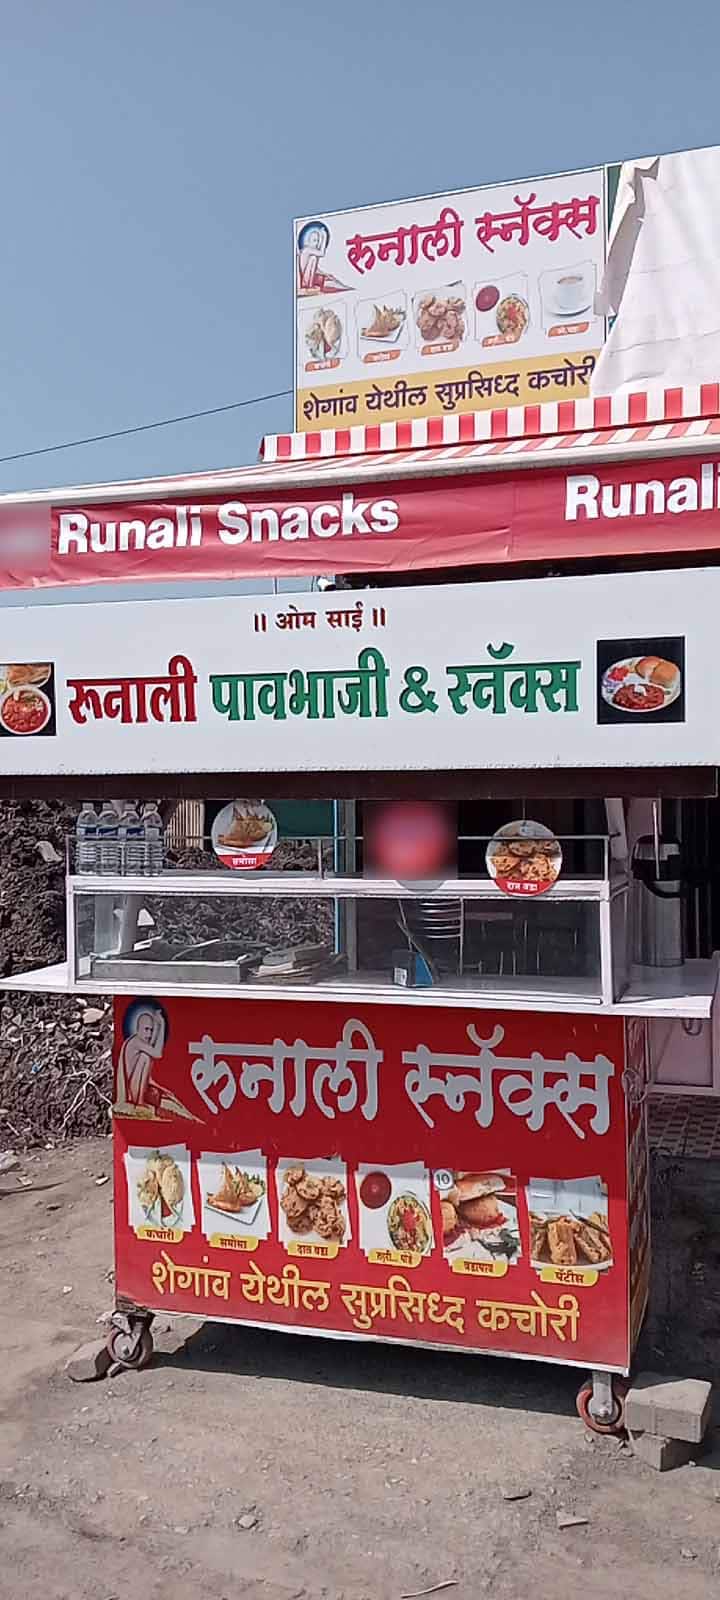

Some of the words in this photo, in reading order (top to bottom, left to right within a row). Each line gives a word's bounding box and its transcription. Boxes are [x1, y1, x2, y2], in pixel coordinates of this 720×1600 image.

[475, 193, 600, 253] स्नॅक्स
[303, 388, 359, 420] शेगांव
[365, 380, 428, 410] येथील
[434, 370, 520, 410] सुप्रसिध्द
[565, 463, 720, 521] Runal
[58, 505, 202, 555] Runali
[216, 492, 400, 545] Snacks
[275, 605, 316, 629] ओम
[326, 601, 363, 632] साई
[209, 647, 390, 721] पावभाजी
[399, 665, 439, 714] &
[446, 641, 582, 715] स्नॅक्स
[402, 1022, 615, 1139] स्नॅक्स
[436, 1173, 450, 1186] 10
[152, 1250, 231, 1300] शेगांव
[239, 1260, 331, 1311] येथील
[339, 1274, 466, 1334] सुप्रसिध्द
[476, 1290, 580, 1342] कचोरी
